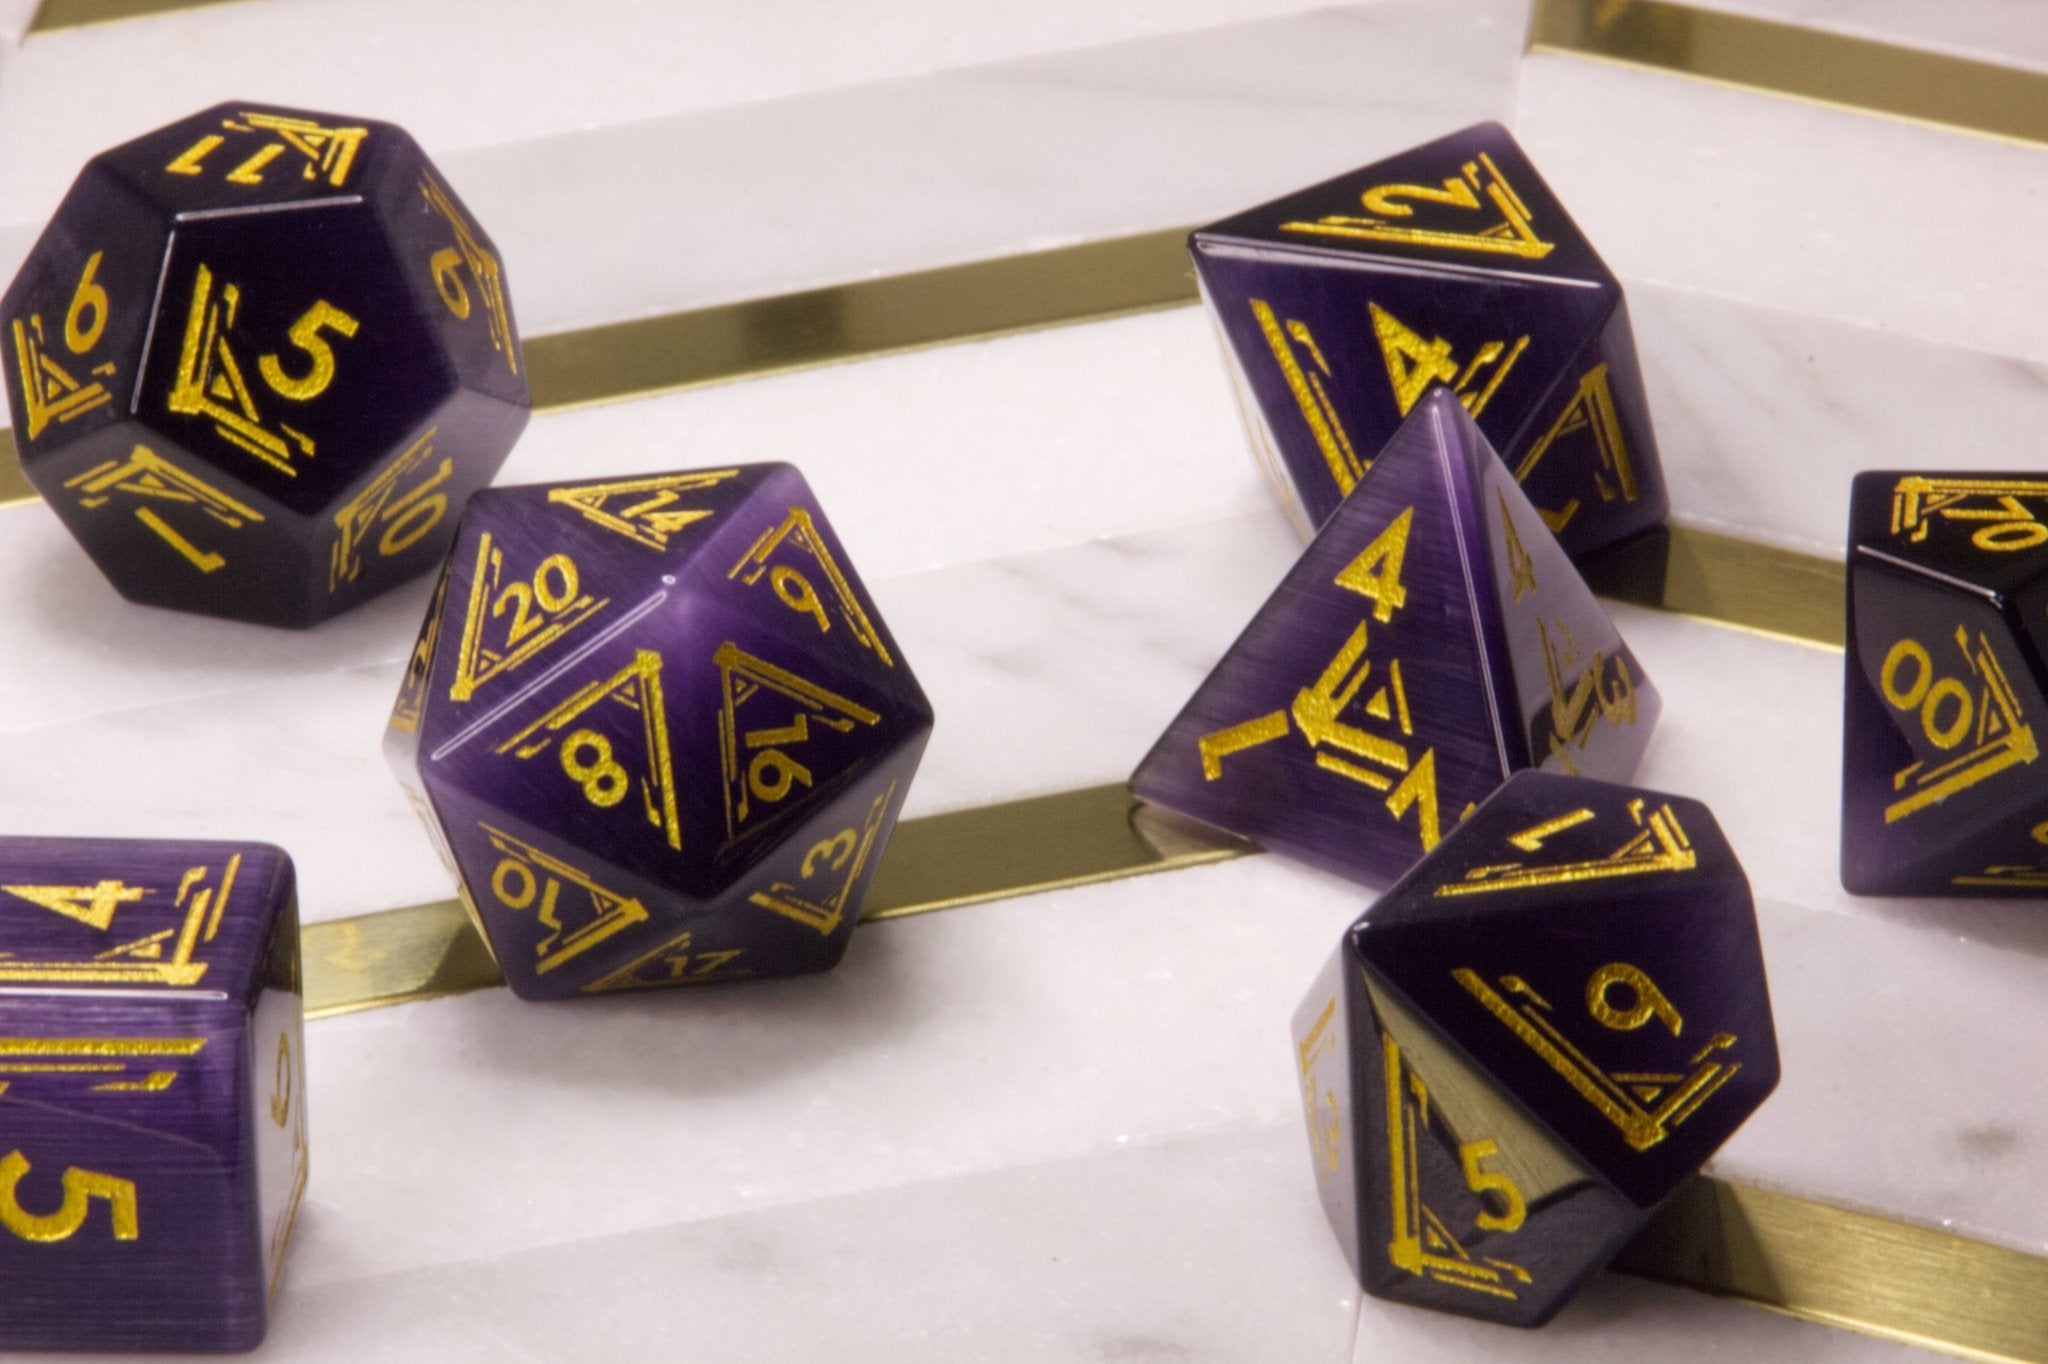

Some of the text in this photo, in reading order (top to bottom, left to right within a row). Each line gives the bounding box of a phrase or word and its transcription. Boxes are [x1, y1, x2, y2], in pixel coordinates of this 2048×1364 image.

[165, 134, 286, 185] 11
[1360, 177, 1482, 217] 2
[258, 299, 360, 401] 5
[1368, 302, 1459, 417] 4
[135, 506, 227, 573] 1
[379, 457, 453, 556] 10
[620, 489, 714, 533] 14
[1498, 486, 1538, 603] 4
[1941, 495, 2048, 552] 10
[492, 553, 580, 648] 20
[1334, 506, 1414, 623] 4
[1880, 639, 1974, 750] 00
[560, 728, 630, 808] 8
[745, 713, 812, 802] 16
[1199, 709, 1290, 782] 1
[801, 827, 859, 879] 3
[1508, 807, 1595, 852] 1
[1, 880, 144, 931] 4
[491, 857, 562, 930] 10
[0, 1149, 139, 1243] 5
[1459, 1138, 1528, 1232] 5
